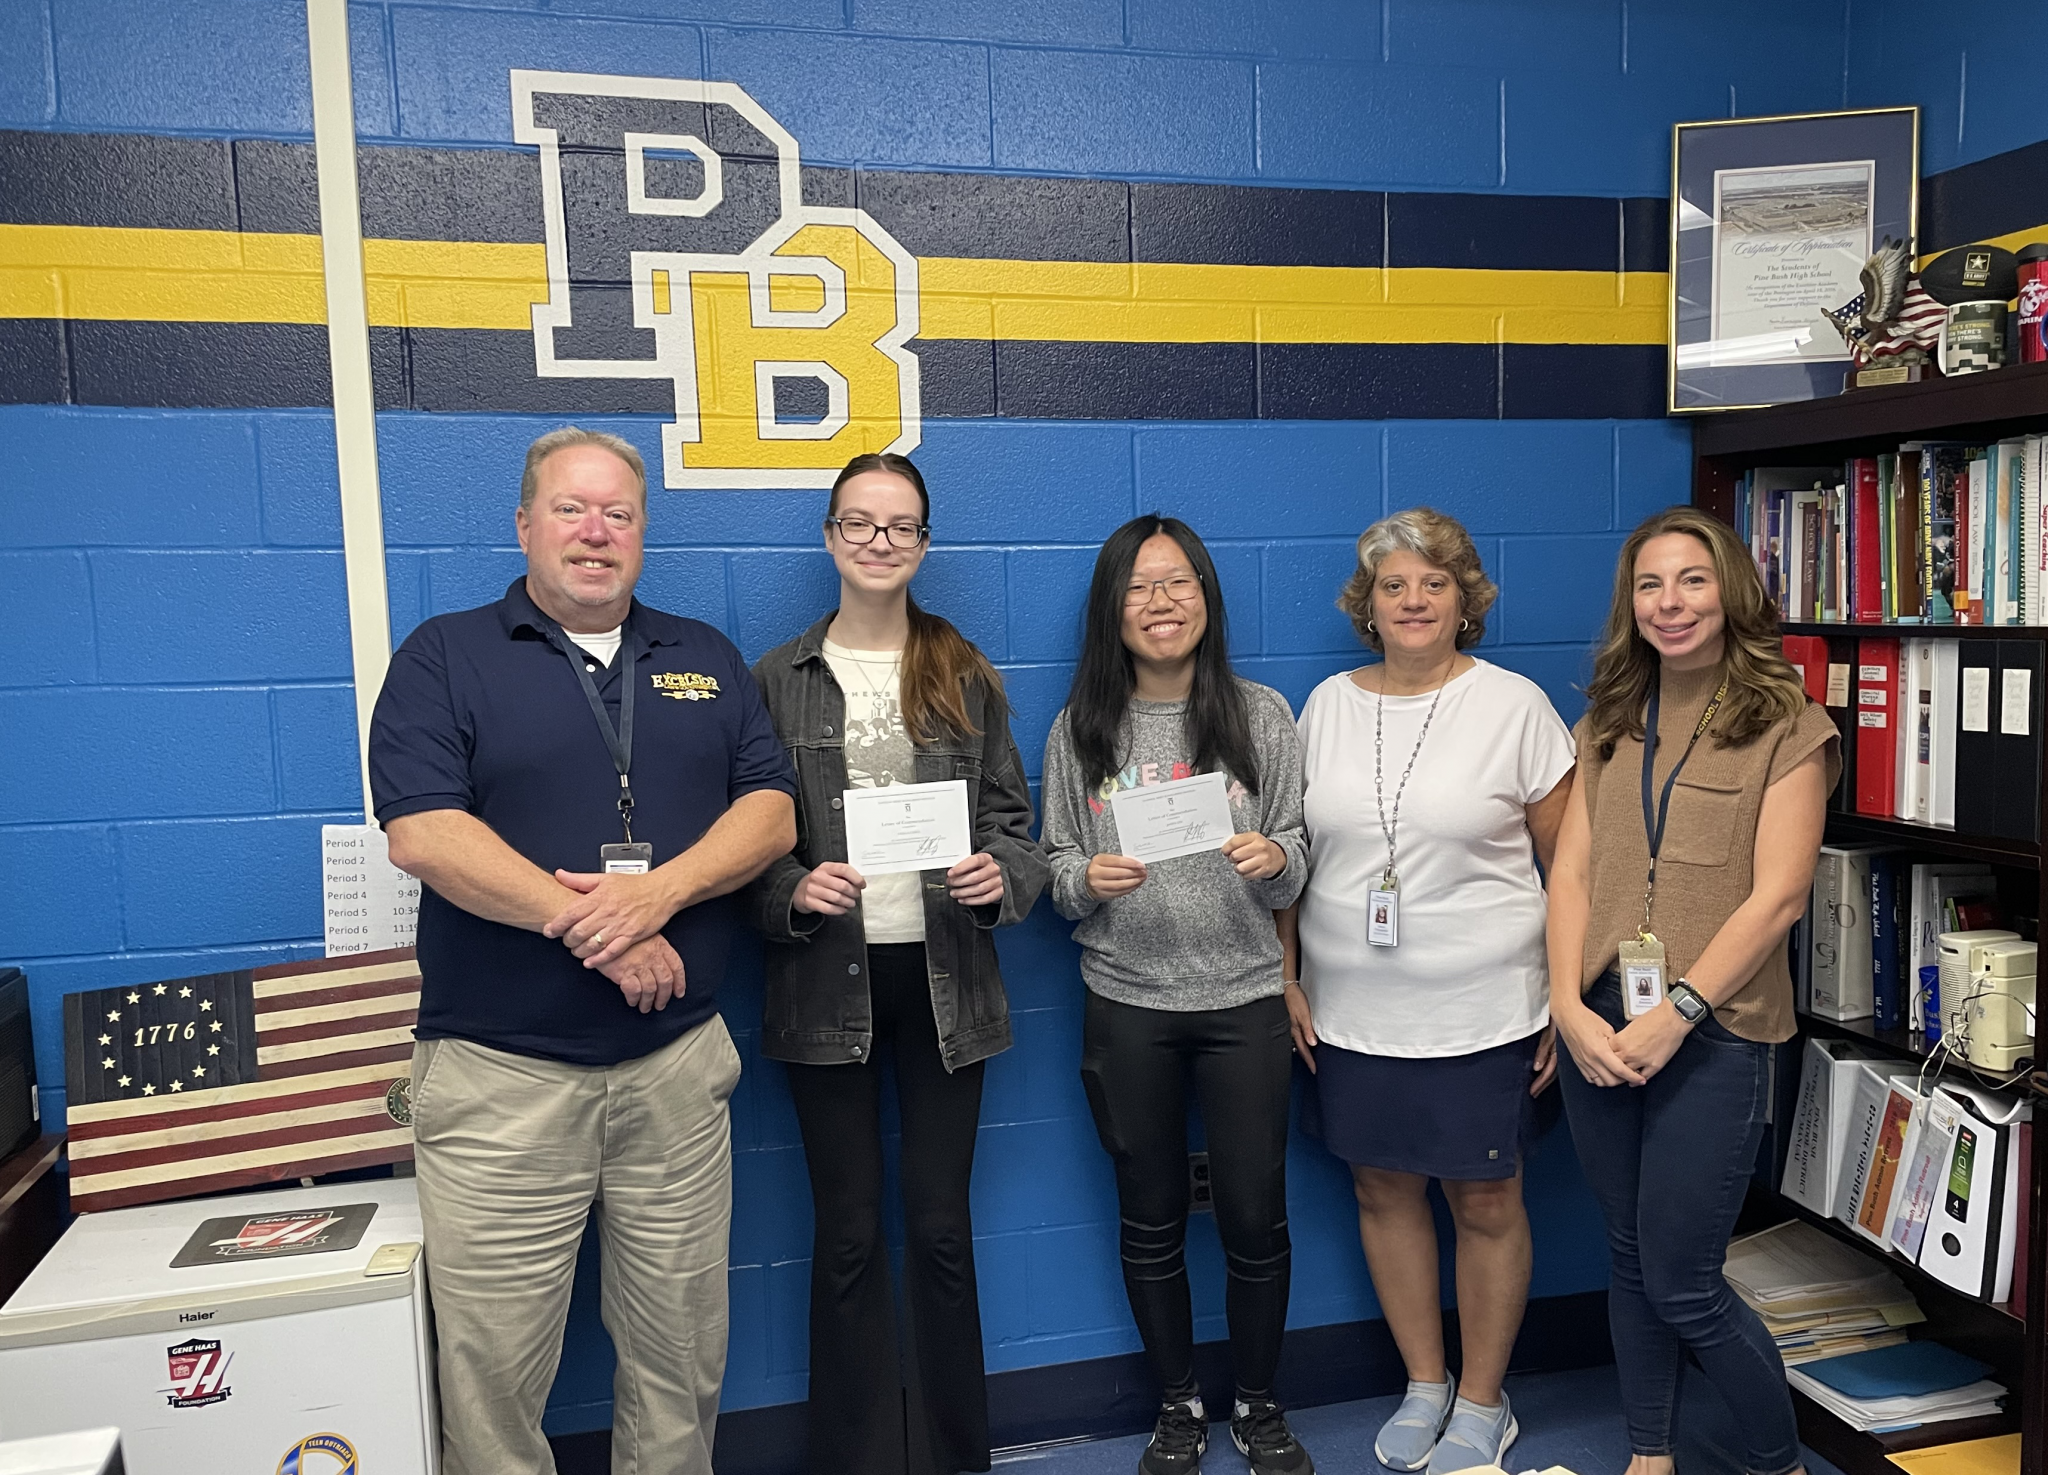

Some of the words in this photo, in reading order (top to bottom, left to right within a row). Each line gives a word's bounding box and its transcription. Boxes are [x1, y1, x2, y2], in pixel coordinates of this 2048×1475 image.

[1781, 263, 1811, 272] Students
[1812, 262, 1821, 271] of
[1790, 271, 1808, 281] High
[1810, 270, 1832, 279] School
[1956, 328, 1982, 337] THERE'S
[1957, 334, 1984, 342] STRONG.
[1923, 478, 1931, 492] 100
[1923, 492, 1932, 514] YEARS
[1972, 477, 1980, 522] SCHOOL
[1924, 515, 1932, 524] OF
[1955, 514, 1961, 522] of
[2040, 504, 2048, 531] Super
[1807, 513, 1817, 556] SCHOOL
[2039, 532, 2048, 571] Teaching
[1807, 559, 1815, 584] LAW
[1953, 557, 1961, 586] Learning
[1696, 703, 1719, 736] SCHOOL
[1715, 683, 1728, 702] DIS
[1087, 762, 1161, 816] LOVE
[326, 839, 356, 848] Period
[359, 839, 365, 847] 1
[326, 857, 357, 865] Period
[359, 857, 365, 865] 2
[327, 874, 357, 882] Period
[360, 874, 366, 882] 3
[327, 891, 358, 900] Period
[361, 891, 367, 899] 4
[397, 889, 419, 898] 9:49
[328, 909, 359, 917] Period
[361, 909, 368, 917] 5
[393, 906, 419, 916] 10:34
[329, 925, 360, 935] Period
[362, 926, 368, 934] 6
[1872, 918, 1881, 937] School
[329, 943, 360, 952] Period
[362, 943, 369, 951] 7
[134, 1021, 196, 1047] 1776
[1809, 1058, 1820, 1104] CENTRAL
[1799, 1081, 1811, 1119] POLICY
[1804, 1107, 1815, 1148] SCHOOL
[1794, 1122, 1804, 1162] MANUAL
[1810, 1133, 1819, 1159] BUSH
[1798, 1150, 1809, 1197] DISTRICT
[1869, 1190, 1877, 1208] Bush
[1874, 1166, 1885, 1190] Admin
[1881, 1137, 1892, 1165] Retreat
[1901, 1228, 1909, 1246] Pine
[1906, 1206, 1915, 1228] Bush
[1912, 1181, 1923, 1207] Admin
[1919, 1155, 1932, 1181] Retreat
[1953, 1199, 1959, 1209] 4
[256, 1216, 289, 1224] GENE
[290, 1213, 325, 1221] HAAS
[236, 1243, 304, 1254] FOUNDATION
[179, 1311, 216, 1323] Haier
[172, 1346, 194, 1355] GENE
[194, 1342, 217, 1352] HAAS
[178, 1395, 221, 1407] FOUNDATION
[308, 1439, 324, 1447] TEEN
[324, 1439, 352, 1460] OUTREACH
